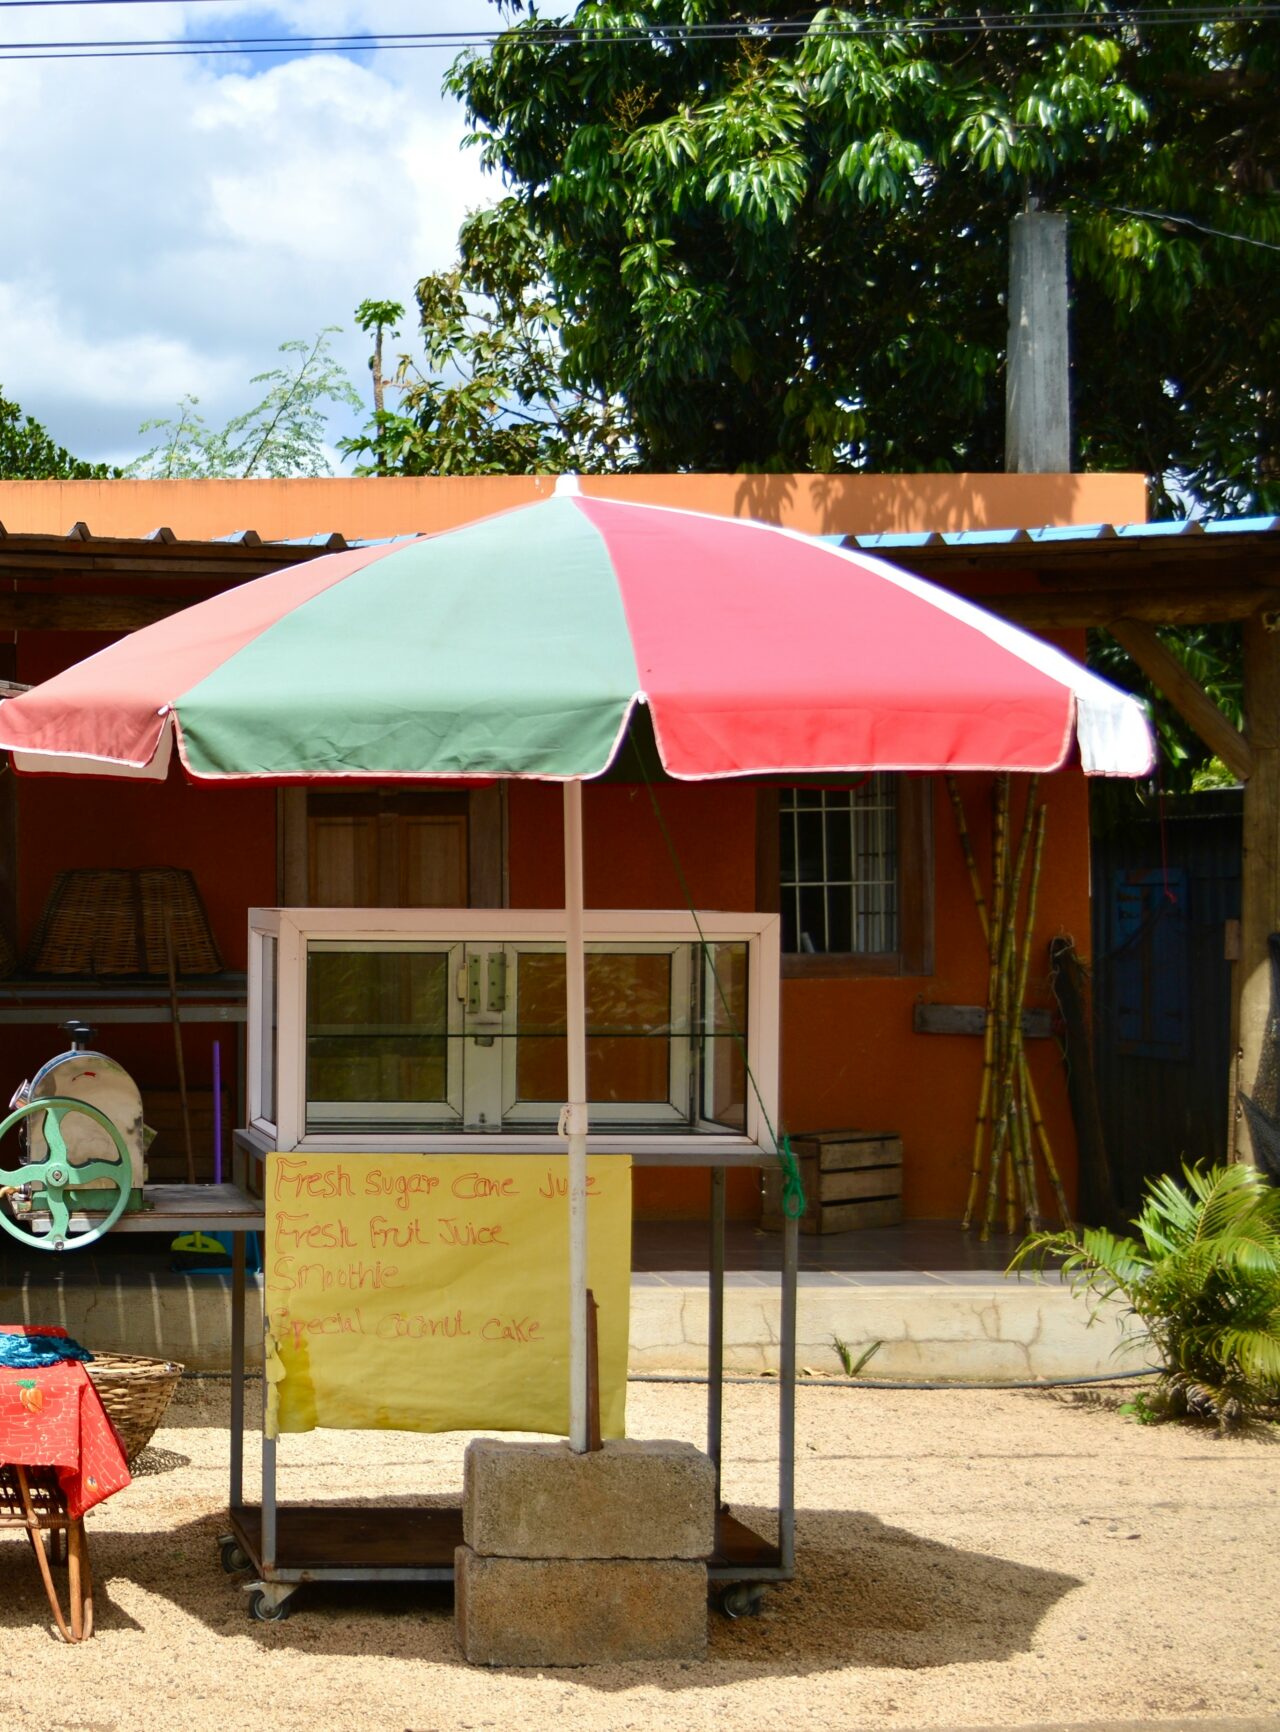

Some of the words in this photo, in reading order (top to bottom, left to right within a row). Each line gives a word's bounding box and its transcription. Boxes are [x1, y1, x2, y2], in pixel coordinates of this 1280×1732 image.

[274, 1157, 356, 1202] Fresh
[274, 1211, 358, 1254] Fresh
[437, 1216, 510, 1246] Juice
[267, 1256, 407, 1291] Smoothie
